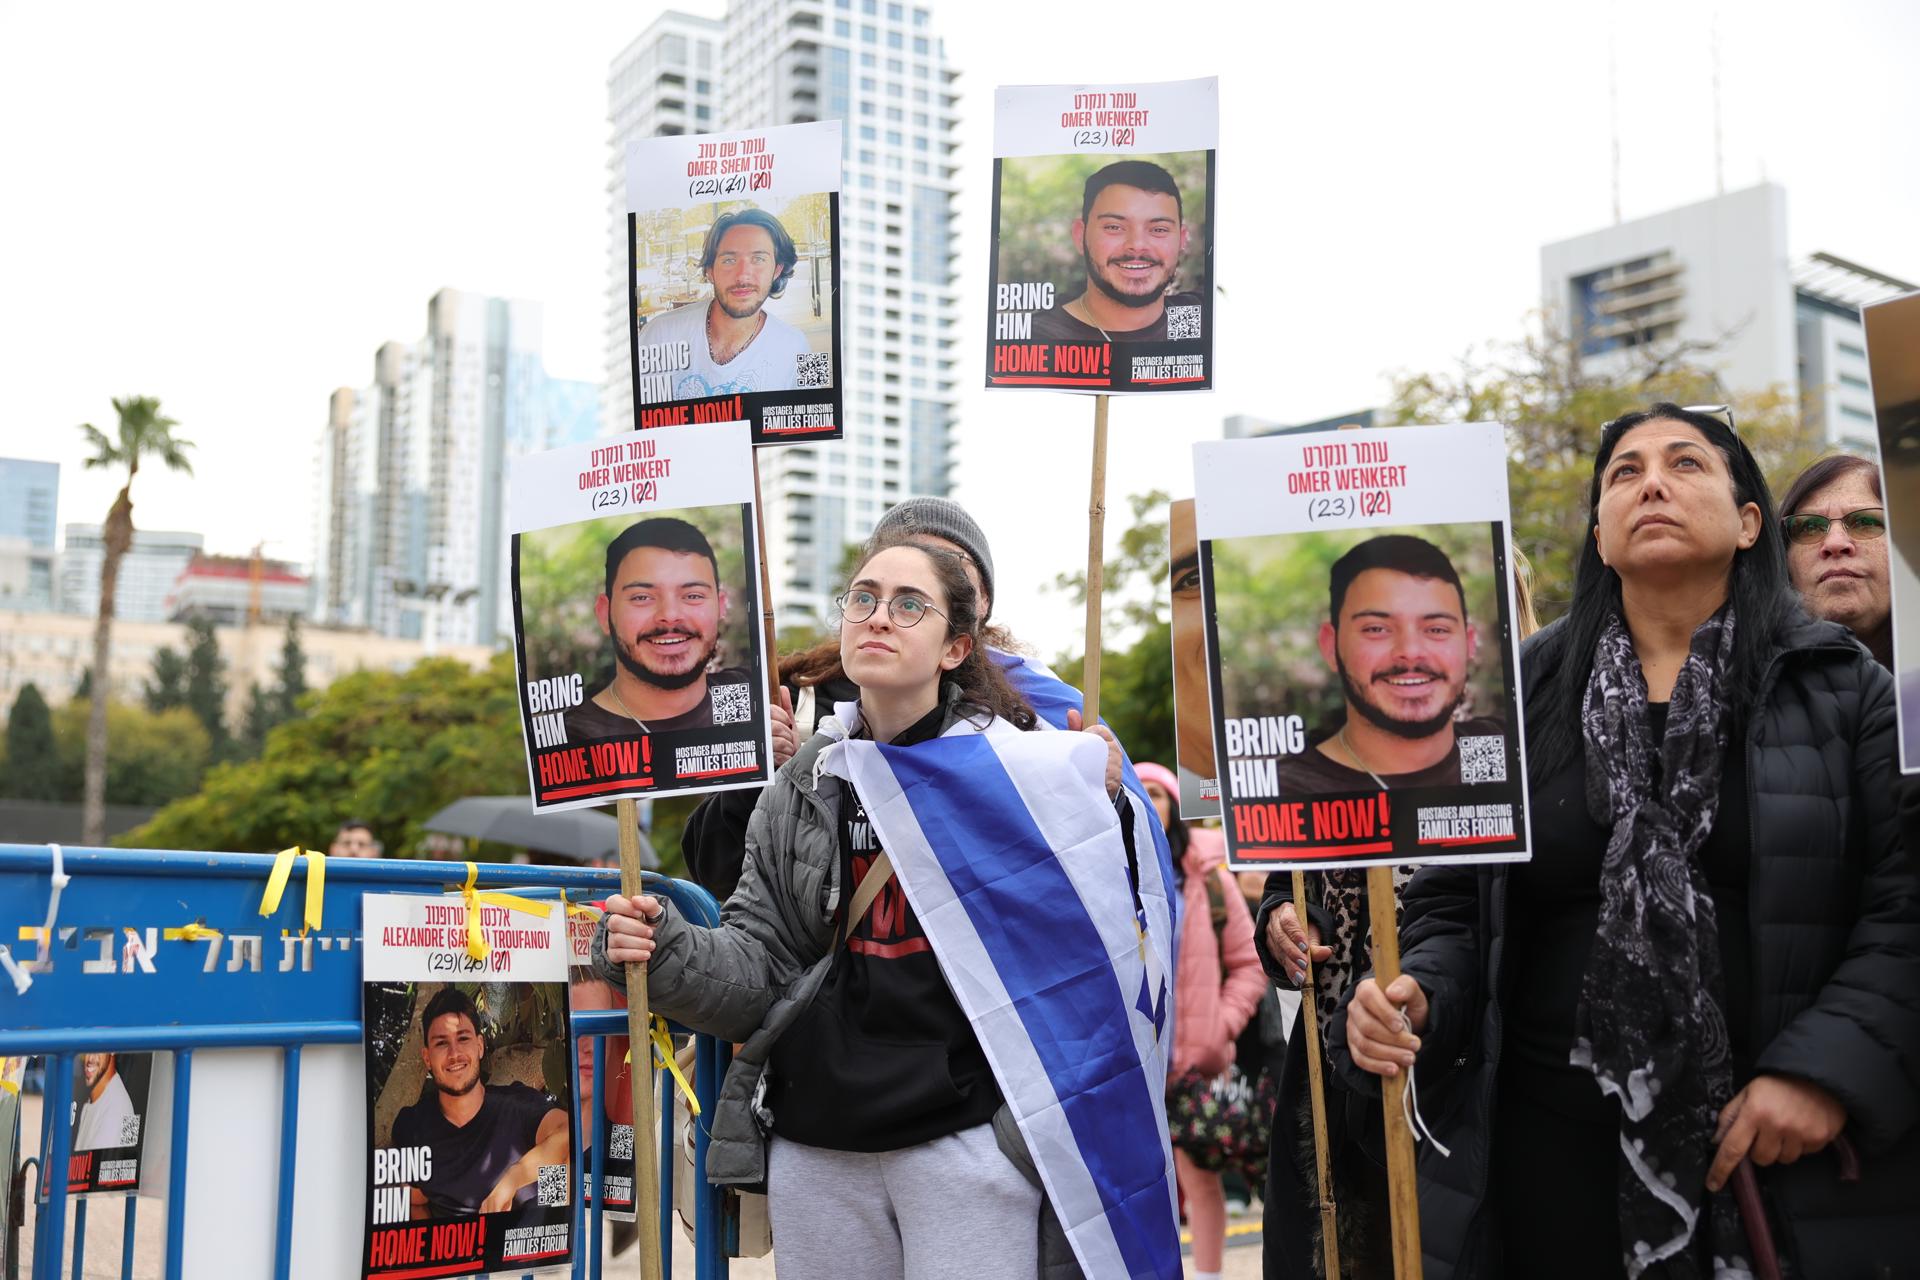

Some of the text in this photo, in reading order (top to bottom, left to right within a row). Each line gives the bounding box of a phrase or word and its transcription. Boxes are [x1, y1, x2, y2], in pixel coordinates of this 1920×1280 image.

[1074, 92, 1137, 110] עומר ונקרט
[1061, 110, 1149, 128] OMER WENKERT
[697, 137, 766, 158] עומר שם טוב
[1073, 128, 1135, 147] (23) (22)
[687, 154, 774, 177] OMER SHEM TOV
[996, 282, 1055, 311] BRING
[995, 312, 1032, 340] HIM
[639, 340, 690, 374] BRING
[994, 343, 1112, 375] HOME NOW!
[1132, 354, 1204, 366] HOSTAGES AND MISSING
[1132, 364, 1204, 380] FAMILIES FORUM
[640, 374, 673, 405] HIM
[762, 403, 834, 416] HOSTAGES AND MISSING
[762, 414, 834, 430] FAMILIES FORUM
[592, 440, 656, 468] עומר ונקרט
[1302, 441, 1388, 468] עומר ונקרט
[579, 458, 671, 490] OMER WENKERT
[1288, 466, 1406, 494] OMER WENKERT
[592, 480, 657, 511] (23) (22)
[1308, 490, 1392, 522] (23) (22)
[527, 673, 584, 714] BRING
[532, 712, 568, 749] HIM
[1225, 715, 1305, 757] BRING
[538, 736, 653, 787] HOME NOW!
[675, 740, 756, 759] HOSTAGES AND MISSING
[676, 752, 758, 775] FAMILIES FORUM
[1228, 759, 1280, 798] HIM
[1234, 792, 1392, 842] HOME NOW!
[1417, 804, 1512, 820] HOSTAGES AND MISSING
[1418, 818, 1514, 840] FAMILIES FORUM
[382, 926, 445, 948] ALEXANDRE
[492, 930, 551, 950] TROUFANOV
[573, 938, 590, 957] (22)
[374, 1146, 432, 1186] BRING
[372, 1186, 411, 1225] HIM
[370, 1216, 486, 1268] HOME NOW!
[505, 1224, 569, 1240] HOSTAGES AND MISSING
[504, 1235, 568, 1258] FAMILIES FORUM
